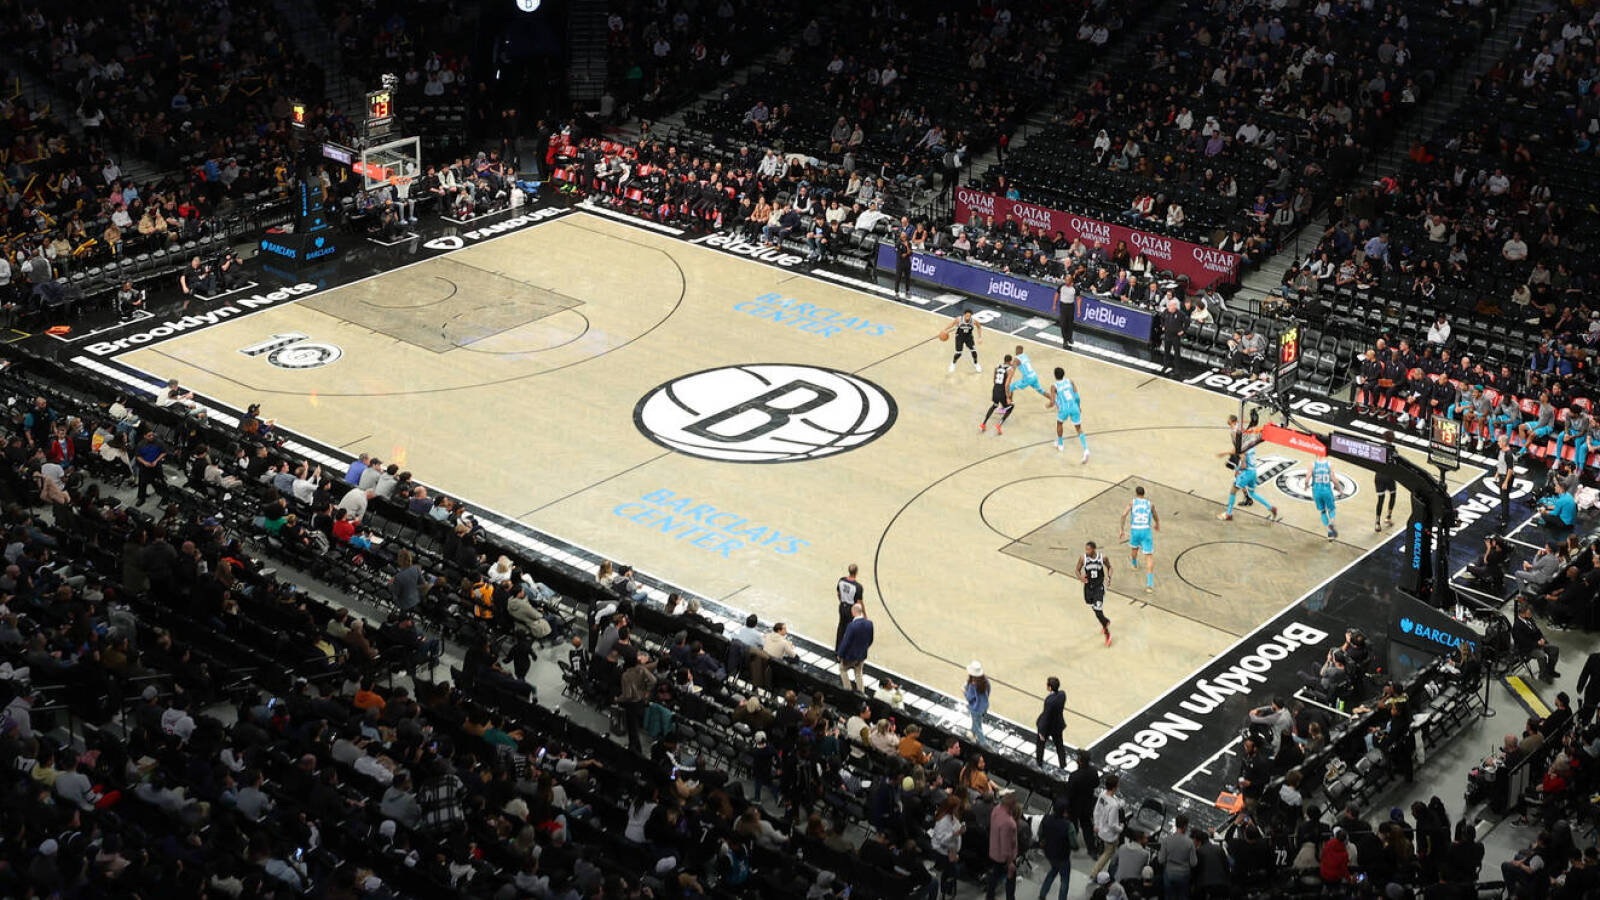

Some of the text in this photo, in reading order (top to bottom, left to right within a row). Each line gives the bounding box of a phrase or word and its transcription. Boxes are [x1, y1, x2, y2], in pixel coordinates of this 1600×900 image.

[958, 190, 995, 209] QATAR
[463, 206, 571, 240] FANDUEL
[1012, 203, 1051, 224] QATAR
[1023, 216, 1051, 231] AIRWAYS
[1070, 218, 1111, 237] QATAR
[1080, 231, 1111, 245] AIRWAYS
[1130, 232, 1172, 252] QATAR
[267, 242, 296, 259] BARCLAYS
[306, 246, 336, 260] BARCLAYS
[688, 231, 803, 267] jetBlue
[1140, 245, 1172, 260] AIRWAYS
[1192, 247, 1235, 266] QATAR
[911, 257, 936, 276] Blue
[987, 277, 1029, 301] jetBlue
[84, 281, 319, 356] Brooklyn Nets
[733, 301, 842, 338] CENTER
[755, 291, 895, 337] BARCLAYS
[1083, 302, 1127, 328] jetBlue
[1284, 341, 1295, 362] 13
[681, 379, 838, 442] B
[1335, 437, 1370, 451] CABINETS
[1315, 473, 1330, 483] 20
[640, 488, 812, 555] BARCLAYS
[1133, 513, 1148, 523] 25
[612, 502, 745, 559] CENTER
[1412, 530, 1422, 569] BARCLAYS
[1104, 622, 1329, 769] Brooklyn Nets
[1274, 849, 1288, 866] 72
